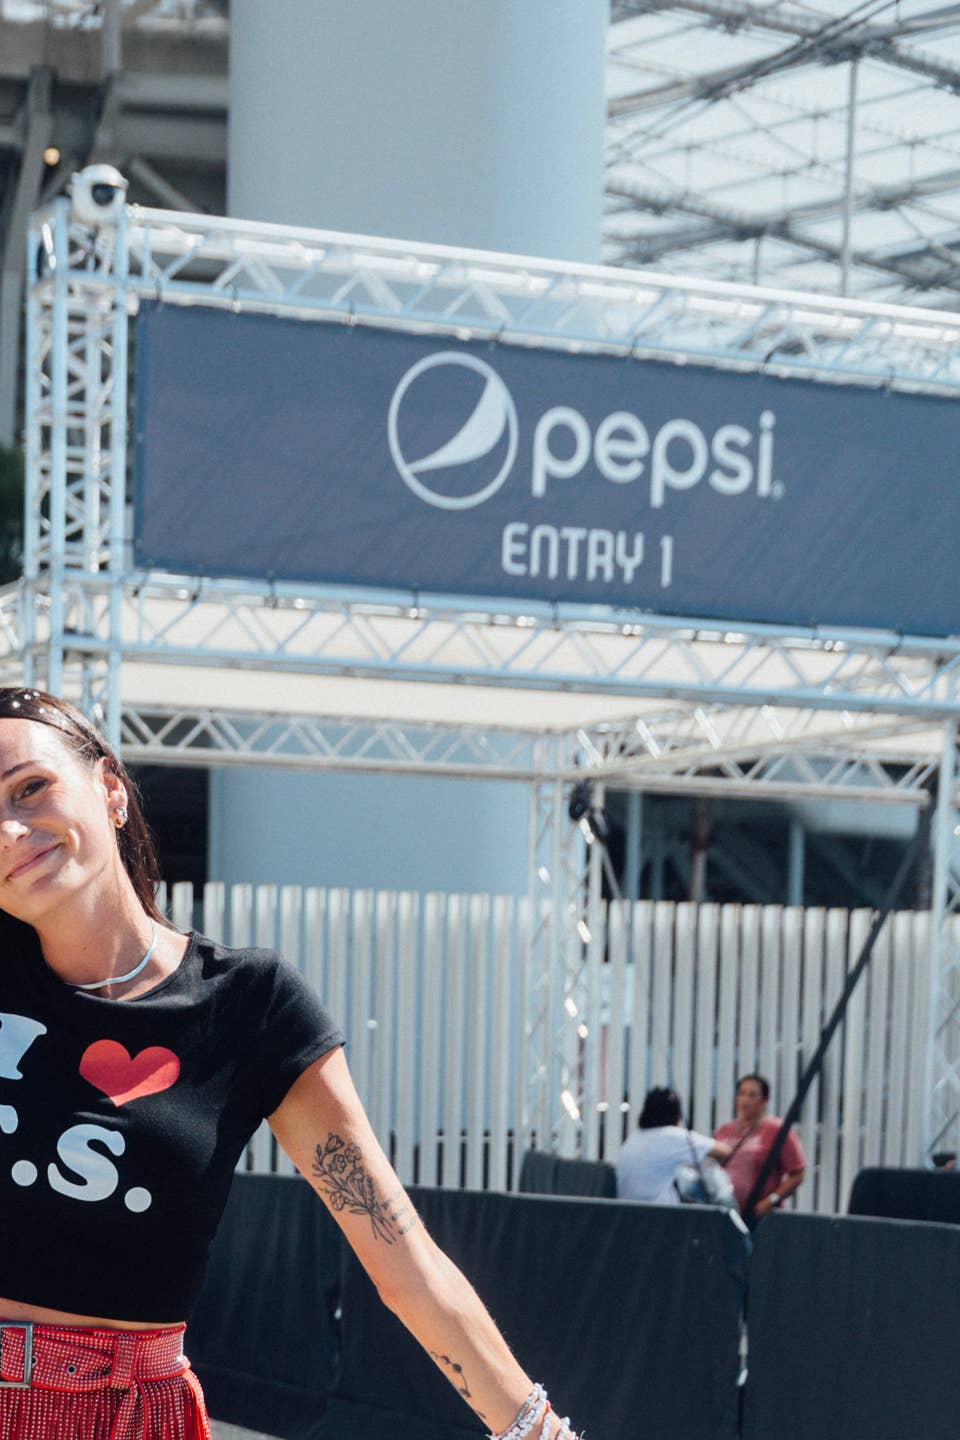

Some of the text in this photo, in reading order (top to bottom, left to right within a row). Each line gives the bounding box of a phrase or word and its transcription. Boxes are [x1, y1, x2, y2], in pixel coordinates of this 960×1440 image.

[531, 406, 776, 508] pepsi
[501, 522, 674, 588] ENTRY 1
